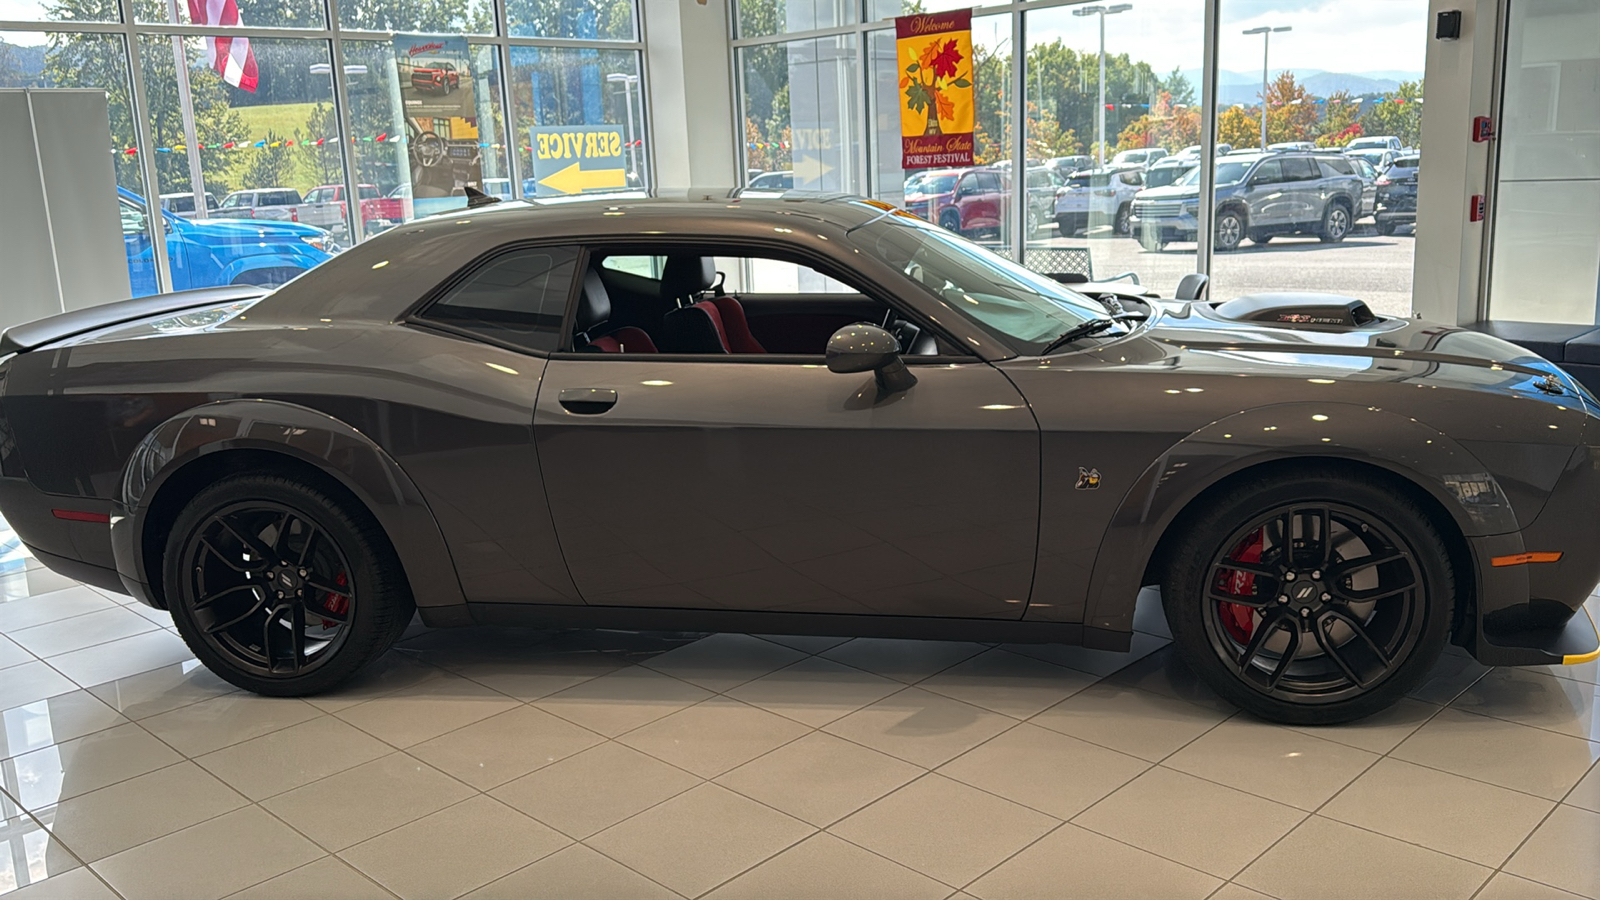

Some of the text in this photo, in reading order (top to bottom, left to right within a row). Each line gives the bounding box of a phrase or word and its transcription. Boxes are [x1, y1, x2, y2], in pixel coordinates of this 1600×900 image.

[911, 16, 954, 33] Welcome
[904, 136, 972, 154] Mountain State
[906, 152, 970, 165] FOREST FESTIVAL
